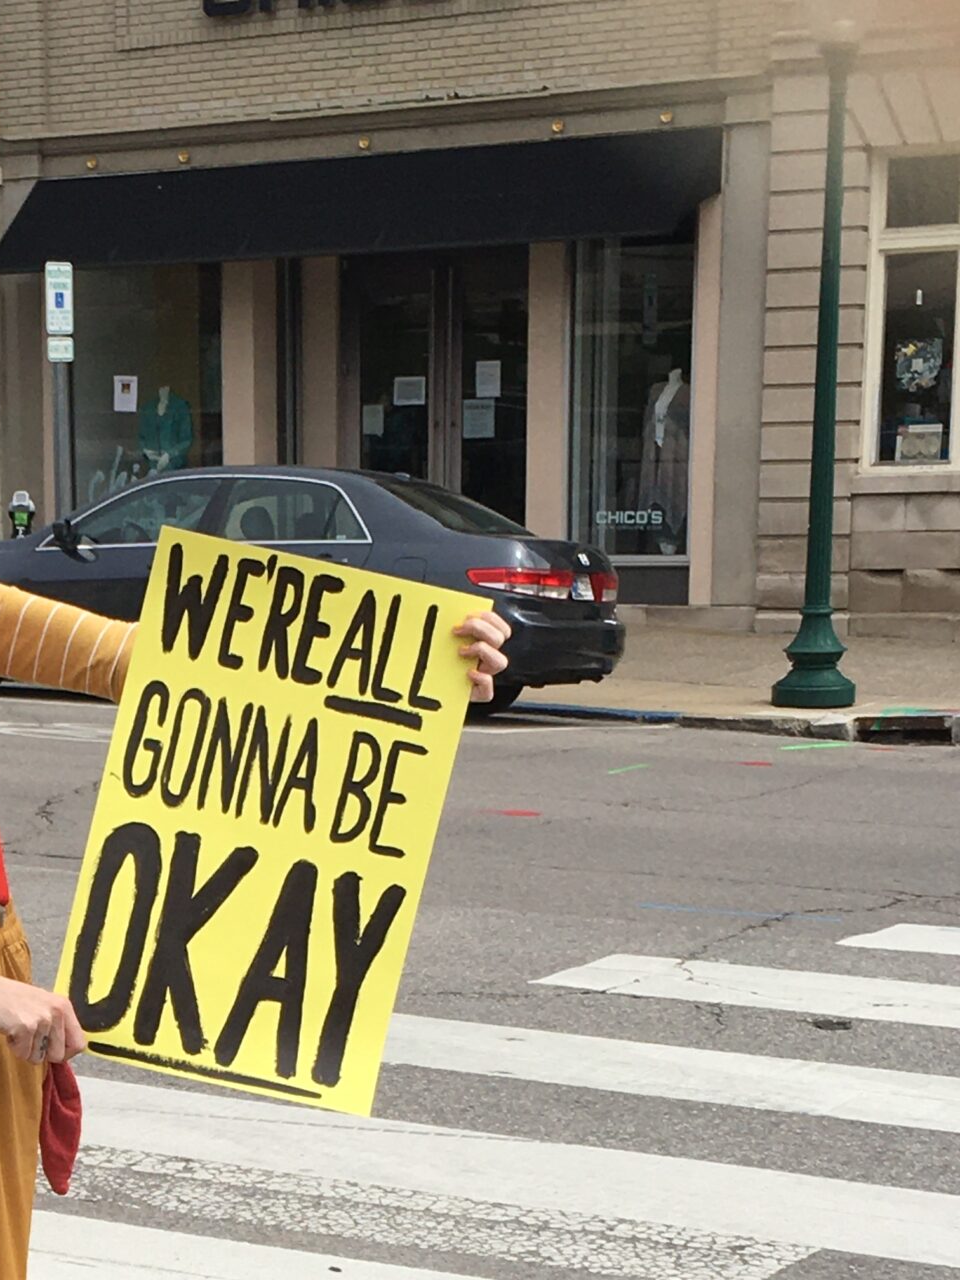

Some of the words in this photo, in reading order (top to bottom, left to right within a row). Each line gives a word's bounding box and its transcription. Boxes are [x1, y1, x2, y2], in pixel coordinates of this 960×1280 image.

[595, 508, 663, 525] CHICO'S
[160, 542, 345, 686] WE'RE
[326, 589, 443, 711] ALL
[122, 680, 318, 834] GONNA
[329, 730, 428, 858] BE
[67, 820, 407, 1087] OKAY
